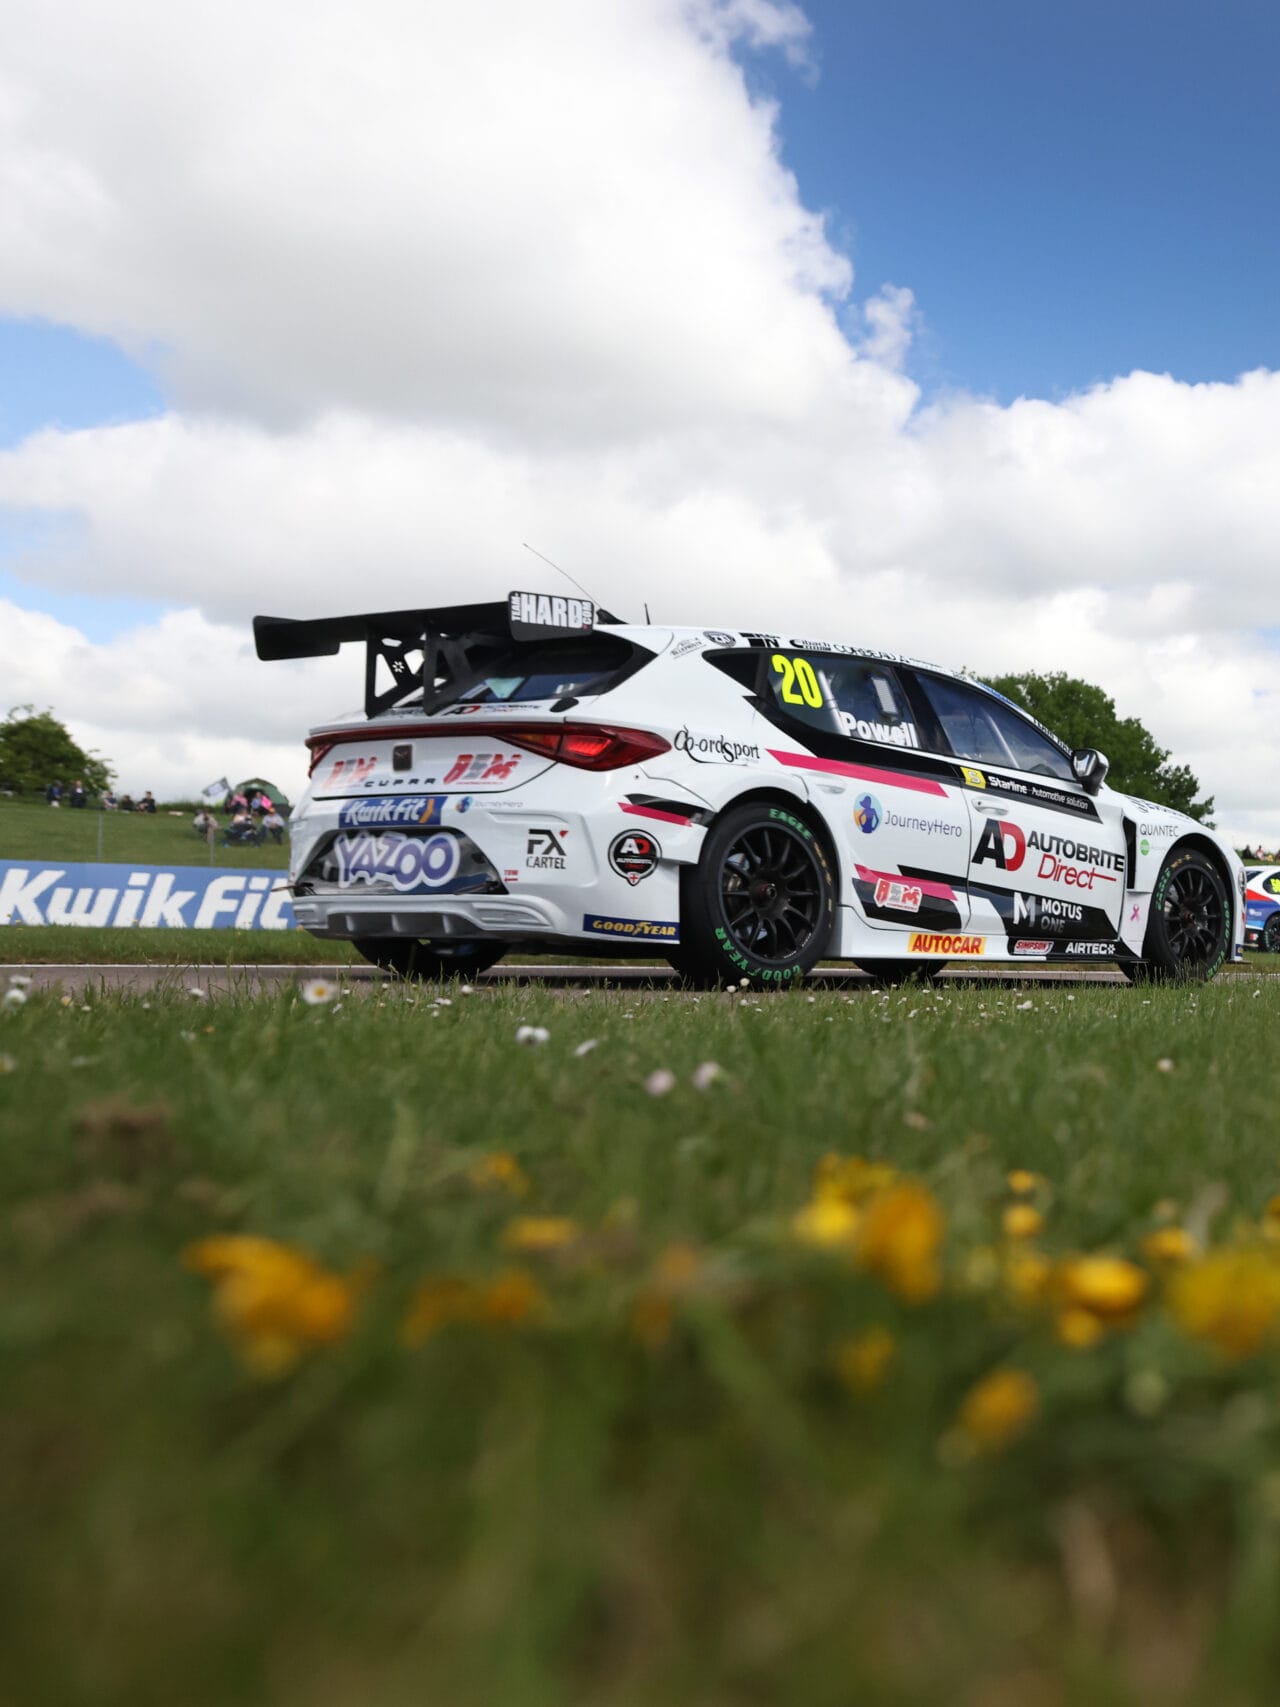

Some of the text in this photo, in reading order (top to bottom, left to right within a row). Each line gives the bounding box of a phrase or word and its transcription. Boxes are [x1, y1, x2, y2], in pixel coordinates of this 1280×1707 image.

[520, 593, 583, 629] HARD
[771, 654, 823, 709] 20
[840, 711, 919, 748] Powell
[988, 776, 1028, 794] Starline
[1032, 787, 1065, 803] Automotive
[1066, 796, 1089, 810] solution
[885, 810, 963, 838] JourneyHero
[1139, 822, 1179, 838] QUANTEC
[527, 828, 569, 857] FX
[1027, 831, 1125, 873] AUTOBRITE
[336, 832, 458, 888] YAZOO
[526, 856, 567, 870] CARTEL
[1038, 853, 1117, 890] Direct
[1041, 898, 1082, 921] MOTUS
[592, 920, 676, 936] GOODYEAR
[1041, 916, 1066, 933] ONE
[911, 934, 982, 954] AUTOCAR
[1015, 941, 1048, 951] SIMPSON
[1065, 942, 1108, 955] AIRTEC
